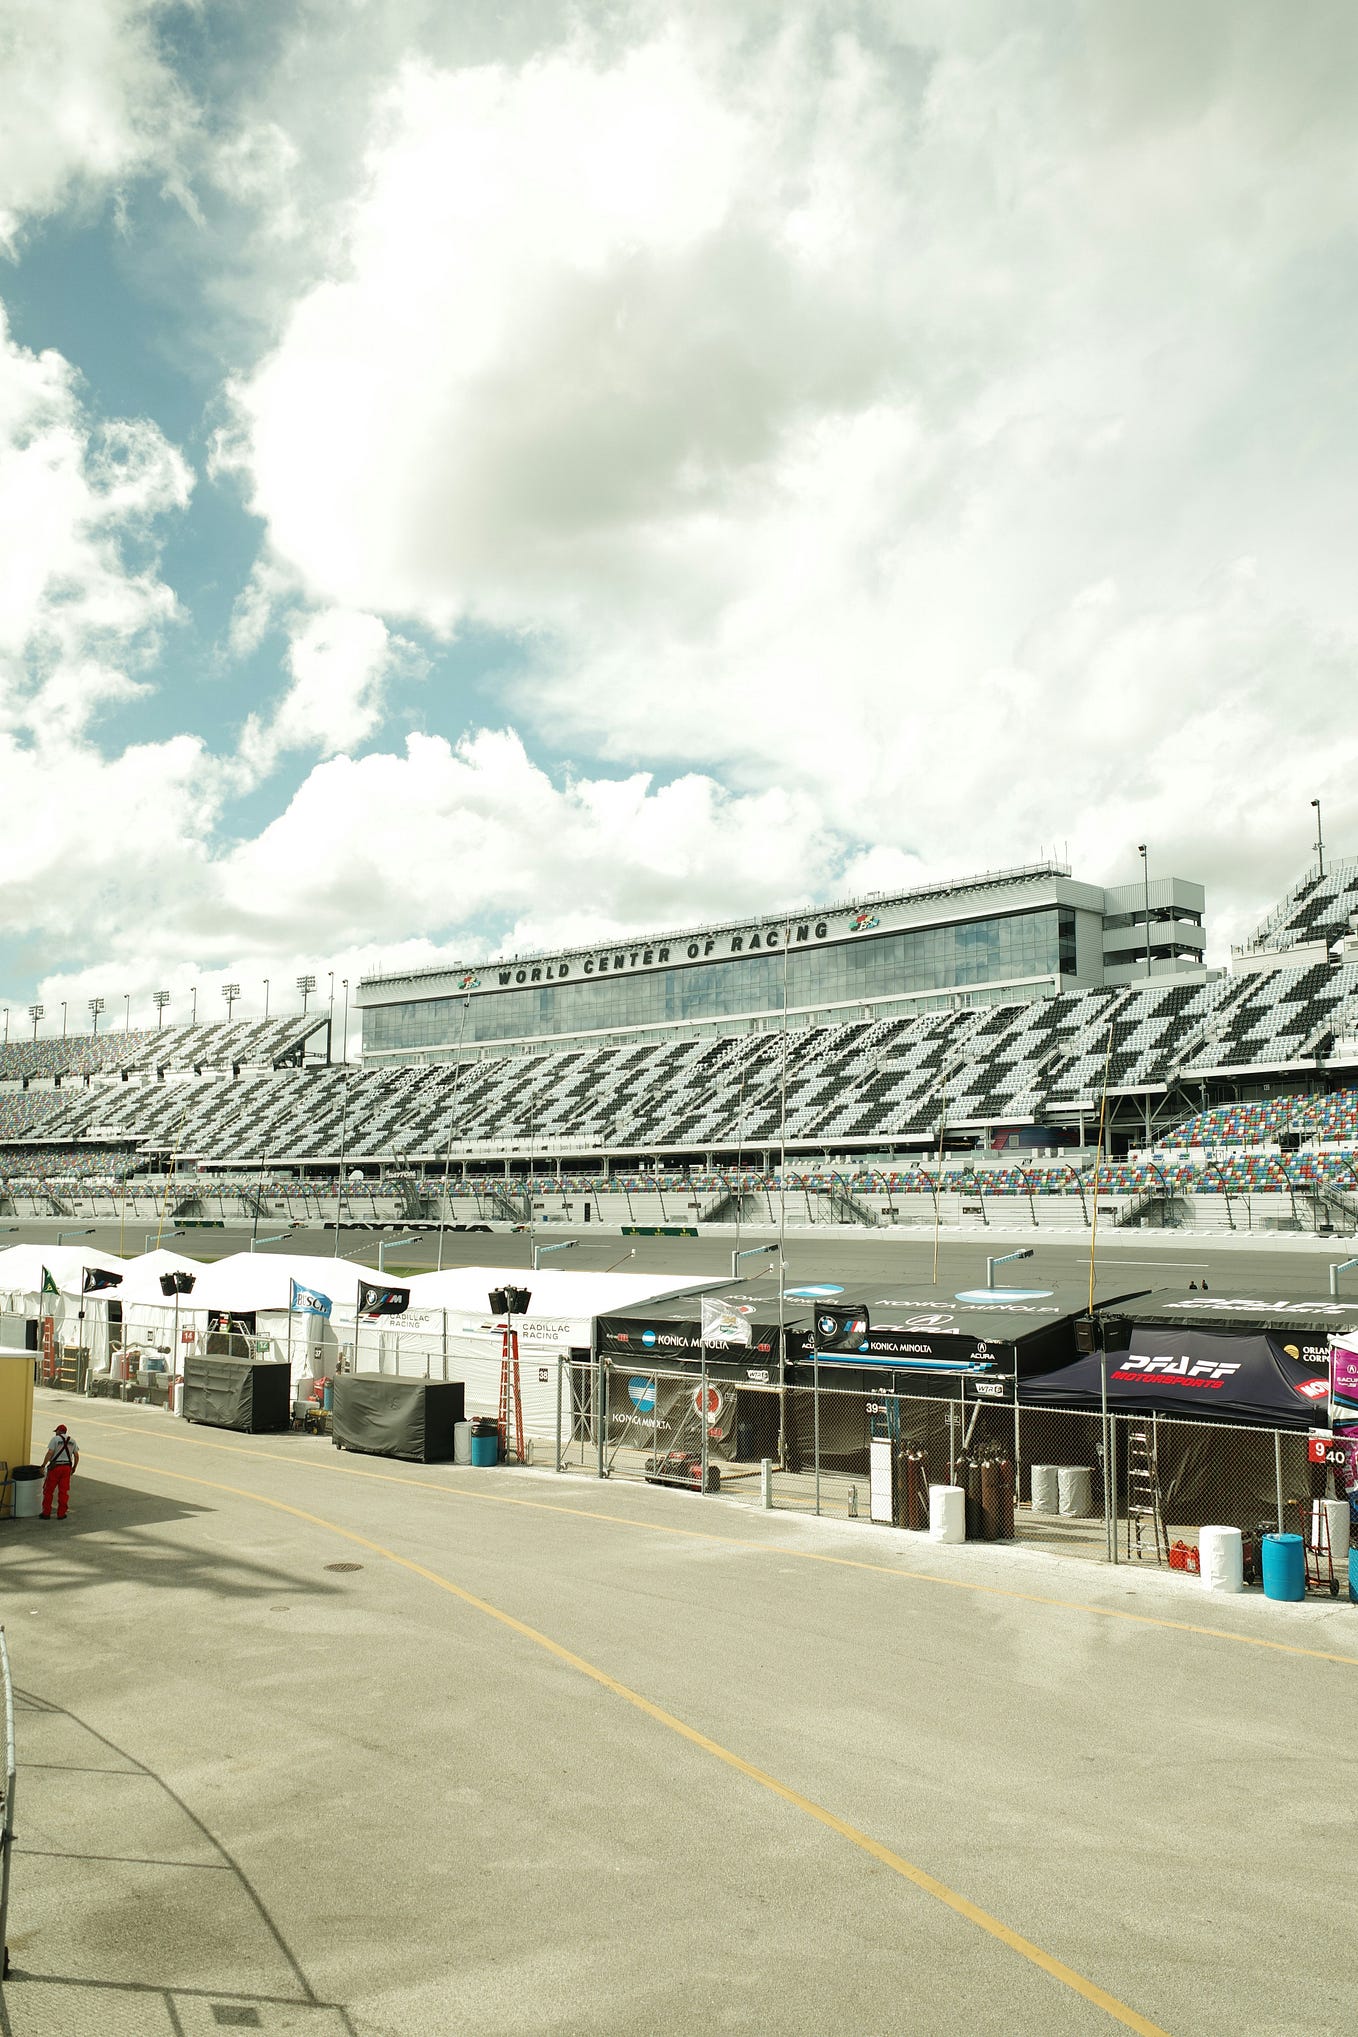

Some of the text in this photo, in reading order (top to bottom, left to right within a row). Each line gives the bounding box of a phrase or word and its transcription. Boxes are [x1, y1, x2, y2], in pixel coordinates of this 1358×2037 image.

[499, 964, 569, 985] WORLD
[584, 948, 670, 974] CENTER
[687, 940, 715, 958] OF
[323, 1222, 494, 1233] DAYTONA
[390, 1313, 429, 1322] CADILLAC
[390, 1320, 420, 1328] RACING
[522, 1323, 570, 1332] CADILLAC
[184, 1332, 194, 1340] 14
[522, 1332, 559, 1340] RACING
[658, 1334, 689, 1348] KONICA
[870, 1341, 932, 1353] KONICA MINOLTA
[1120, 1354, 1242, 1379] PFAFF
[539, 1370, 548, 1380] 38
[1110, 1370, 1225, 1389] MOTORSPORTS
[866, 1403, 879, 1413] 39
[1315, 1442, 1325, 1457] 9
[1326, 1451, 1345, 1464] 40
